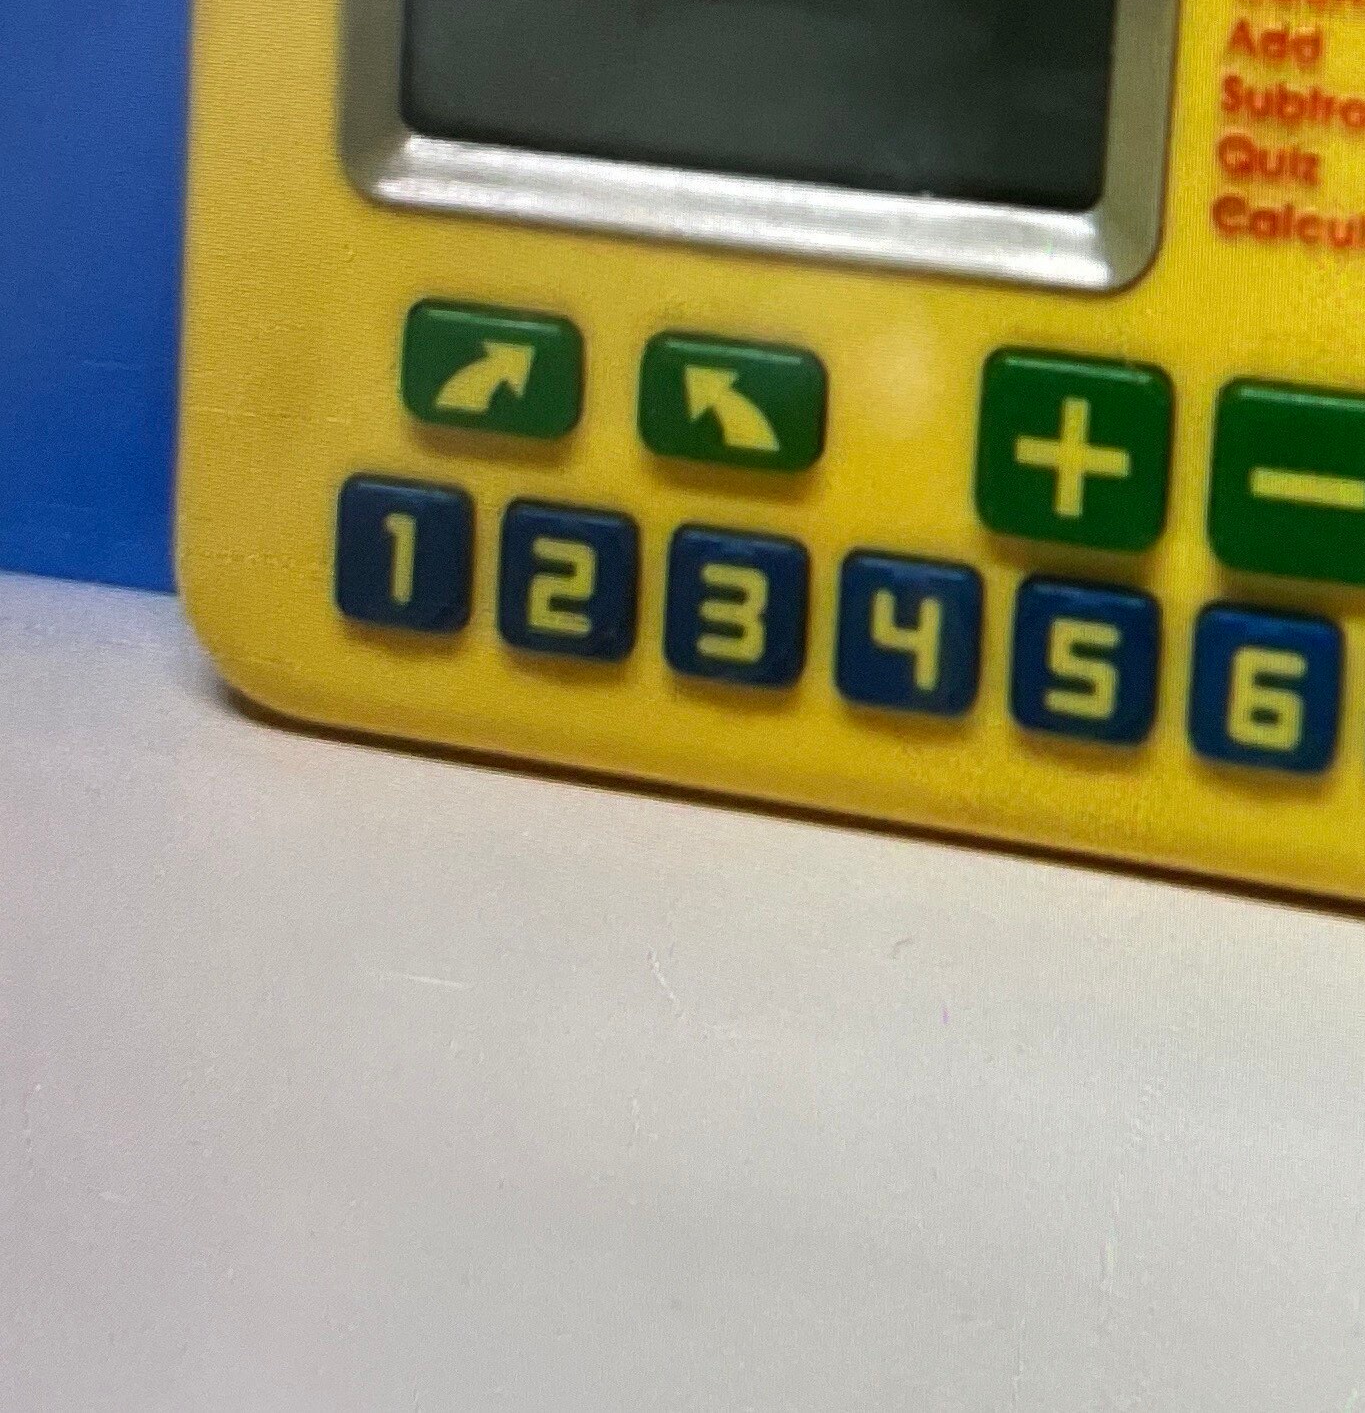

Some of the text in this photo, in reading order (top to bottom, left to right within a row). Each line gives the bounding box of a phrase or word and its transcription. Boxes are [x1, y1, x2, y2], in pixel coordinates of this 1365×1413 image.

[1228, 17, 1324, 64] Add
[1216, 133, 1321, 184] Quiz
[385, 512, 417, 606] 1
[527, 537, 597, 635] 2
[697, 563, 769, 663] 3
[869, 588, 942, 692] 4
[1043, 617, 1122, 720] 5
[1226, 646, 1308, 752] 6
